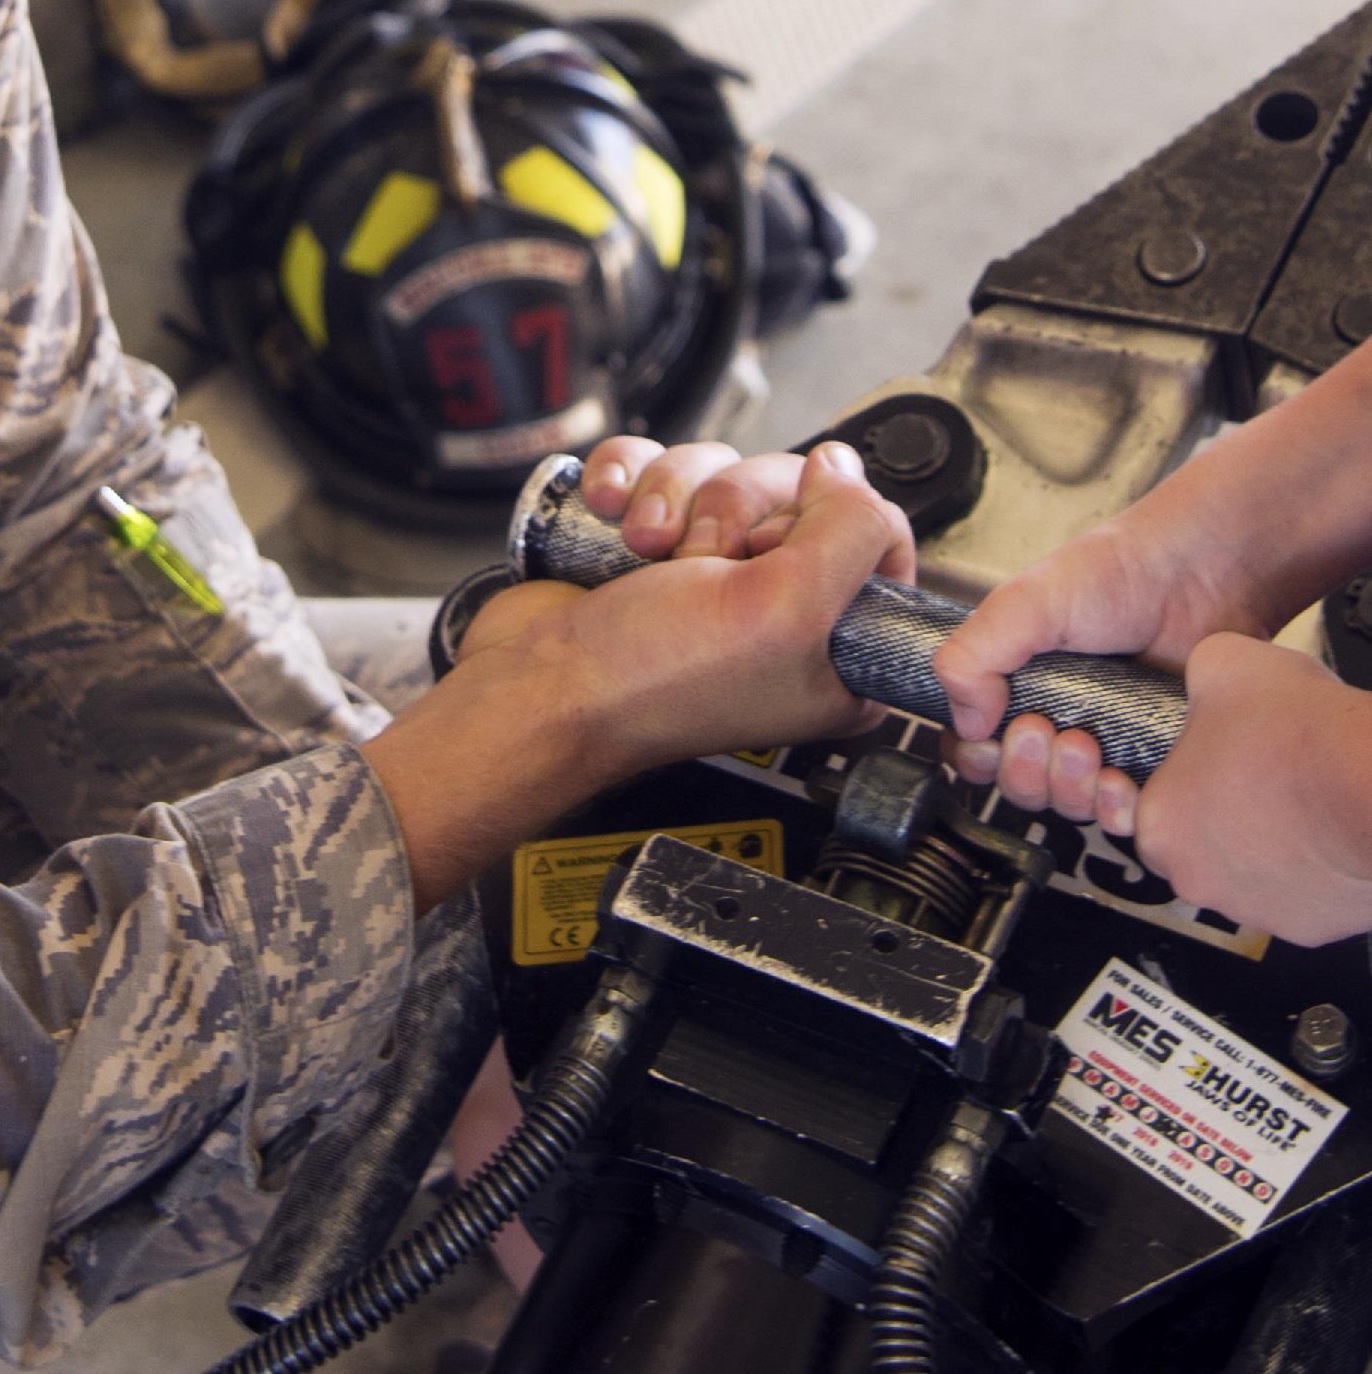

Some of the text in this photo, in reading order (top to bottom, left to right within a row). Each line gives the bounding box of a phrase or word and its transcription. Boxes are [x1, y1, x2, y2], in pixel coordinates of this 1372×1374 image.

[1088, 991, 1181, 1064] MES
[1107, 969, 1130, 988] FOR
[1129, 983, 1162, 1009] SALES
[1170, 1010, 1214, 1043] SERVICE
[1186, 1079, 1230, 1110] JAWS
[1232, 1109, 1254, 1126] OF
[1201, 1065, 1310, 1144] HURST
[1131, 1146, 1156, 1167] YEAR
